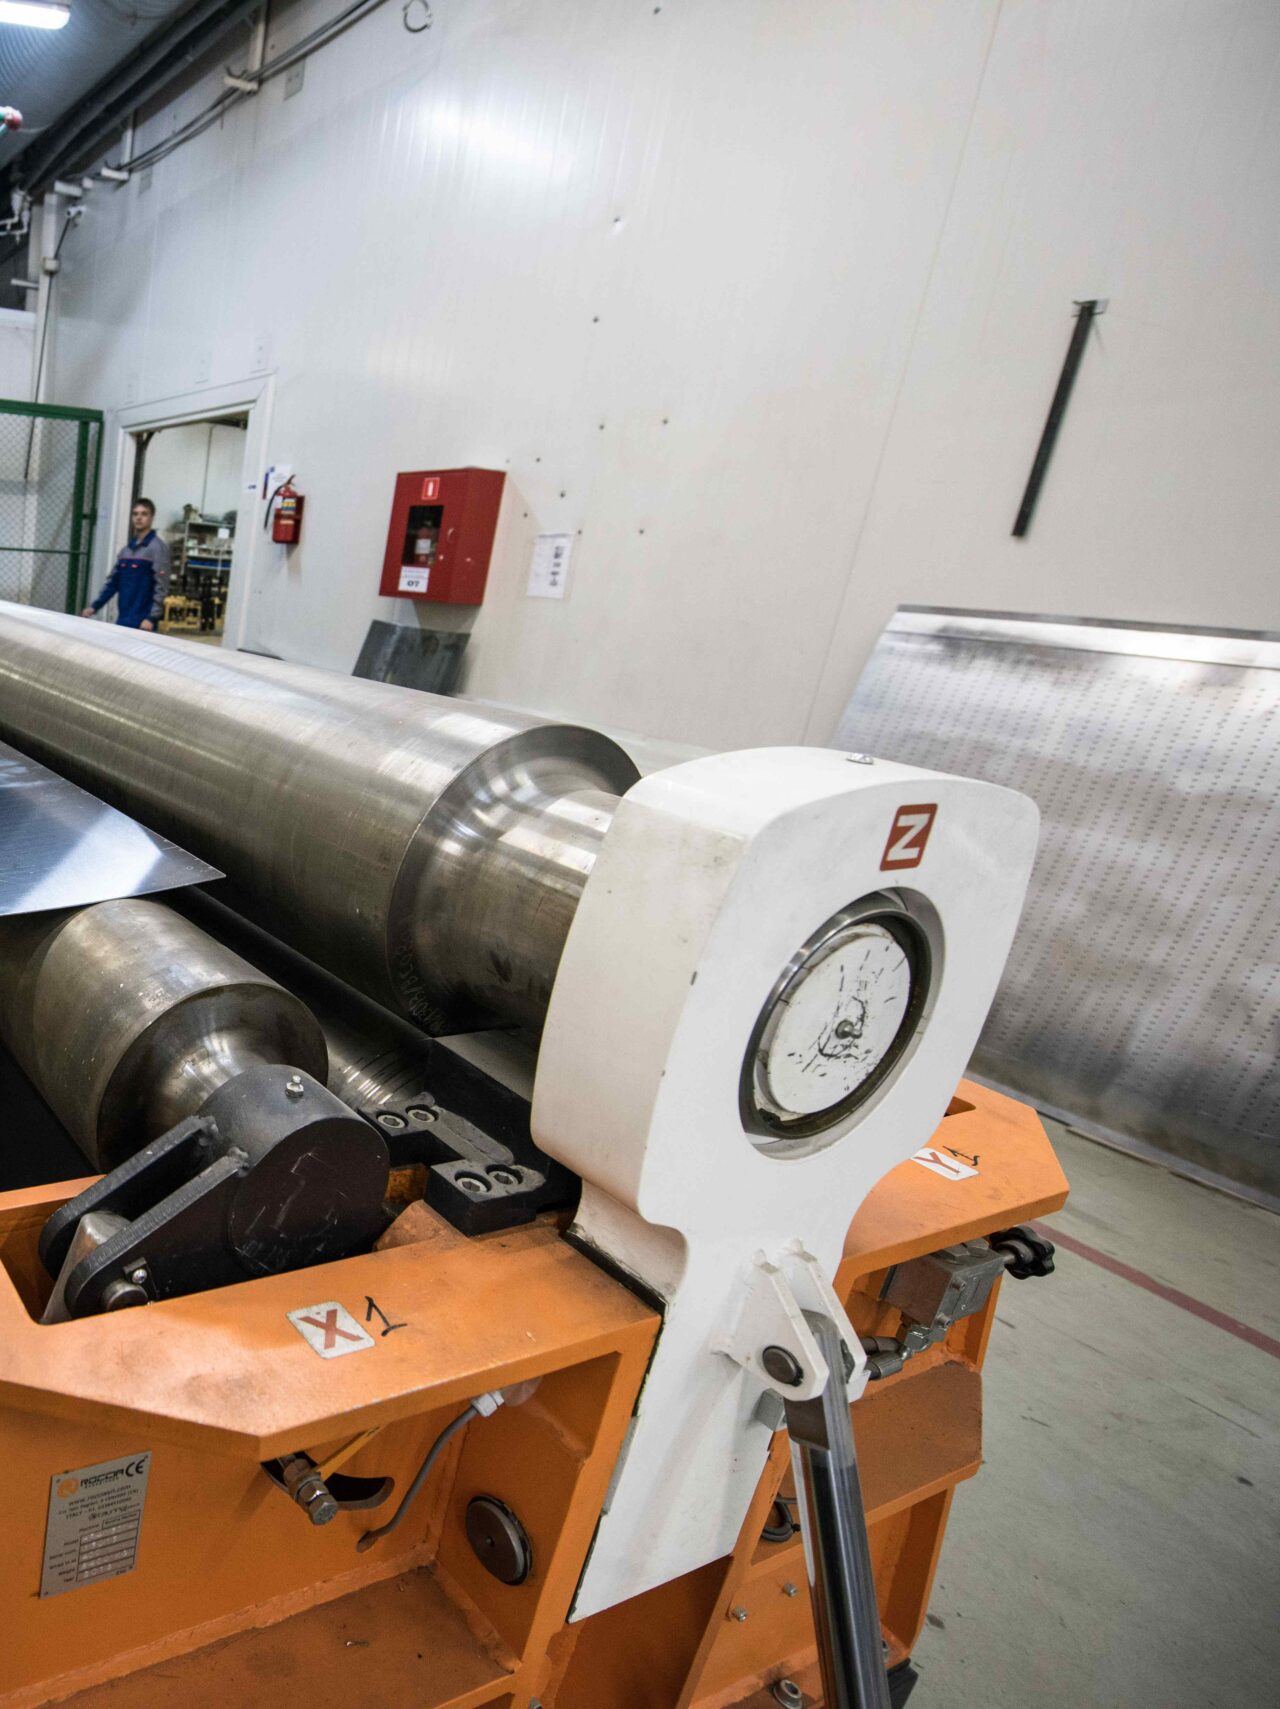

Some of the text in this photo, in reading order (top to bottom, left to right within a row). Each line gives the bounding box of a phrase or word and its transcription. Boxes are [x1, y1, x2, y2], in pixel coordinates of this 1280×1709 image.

[886, 813, 931, 861] Z
[914, 1151, 960, 1175] Y
[296, 1308, 365, 1350] X
[364, 1296, 408, 1337] 1
[125, 1460, 144, 1477] CE
